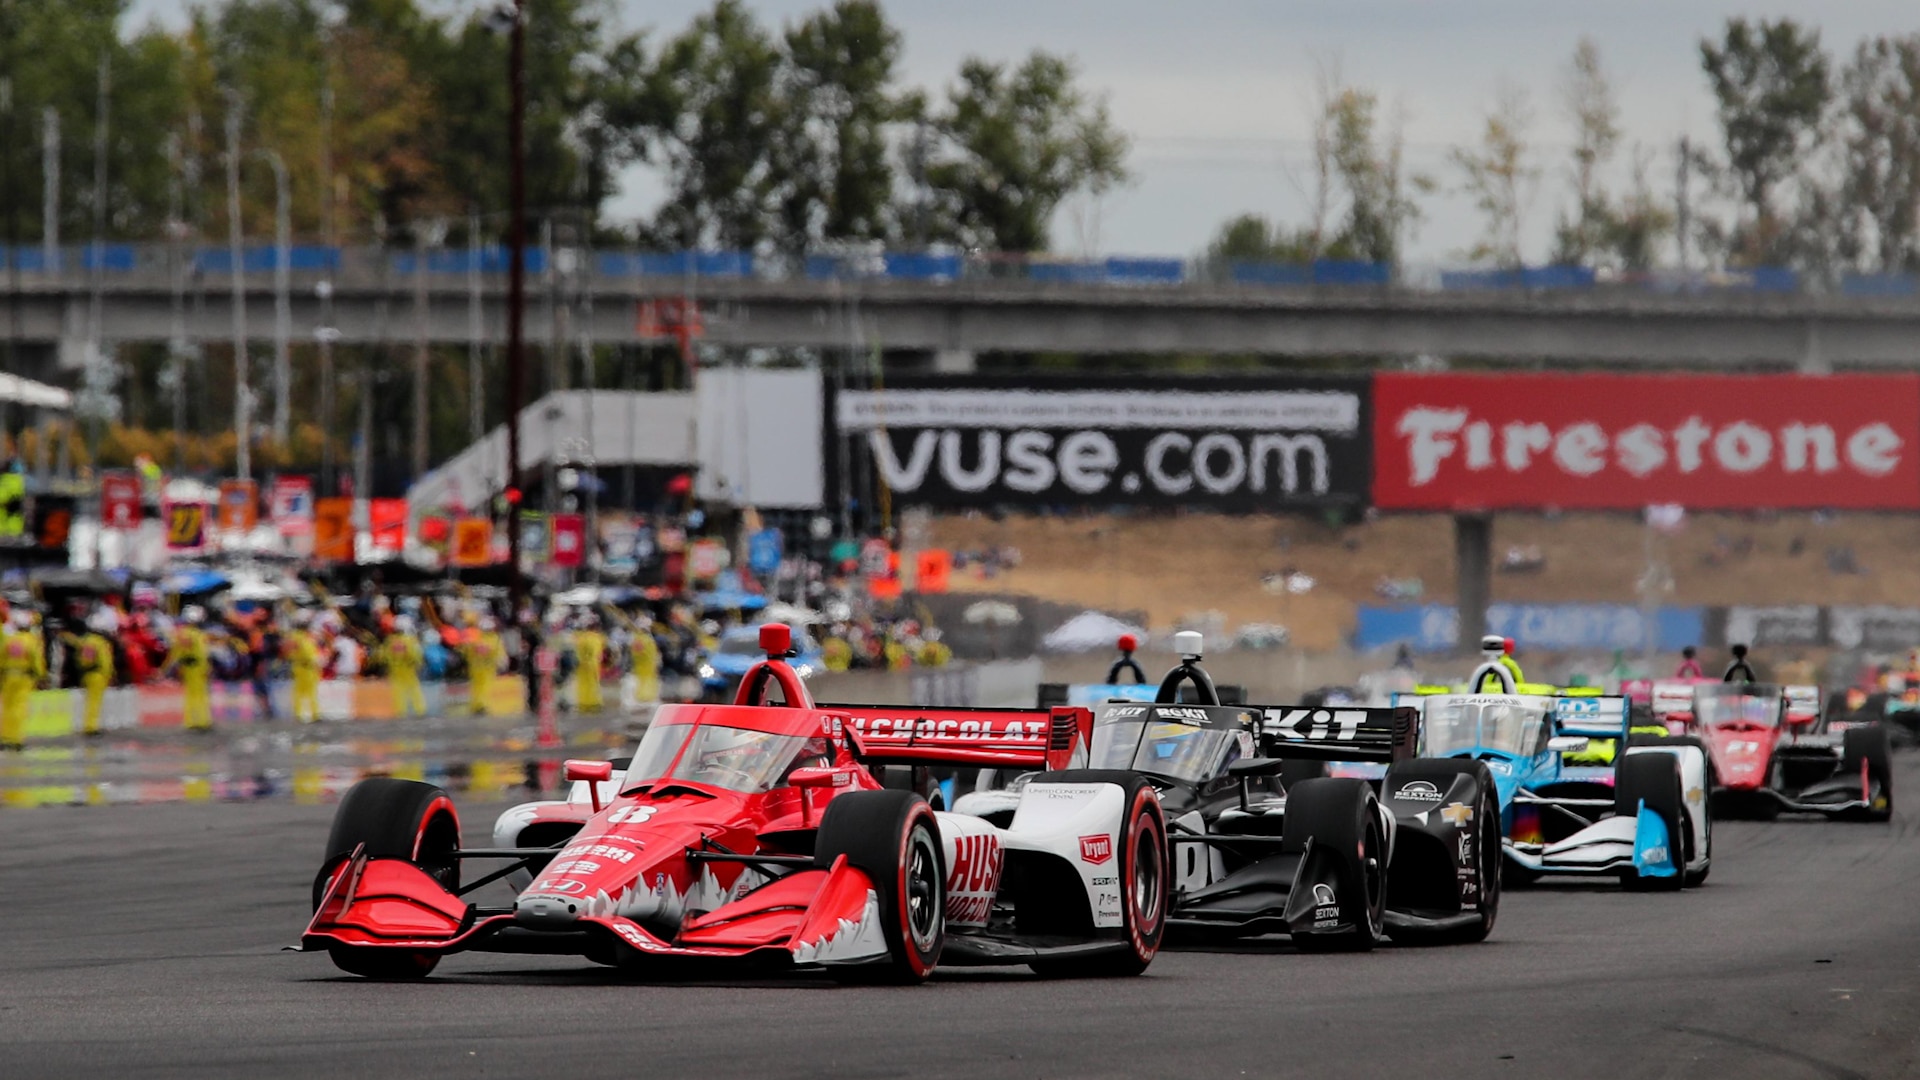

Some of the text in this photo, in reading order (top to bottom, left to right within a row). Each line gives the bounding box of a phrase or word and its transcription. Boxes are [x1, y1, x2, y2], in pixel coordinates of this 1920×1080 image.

[871, 428, 1331, 494] vuse.com
[1397, 404, 1902, 486] Firestone
[607, 805, 658, 824] 8
[1083, 839, 1110, 859] bryant
